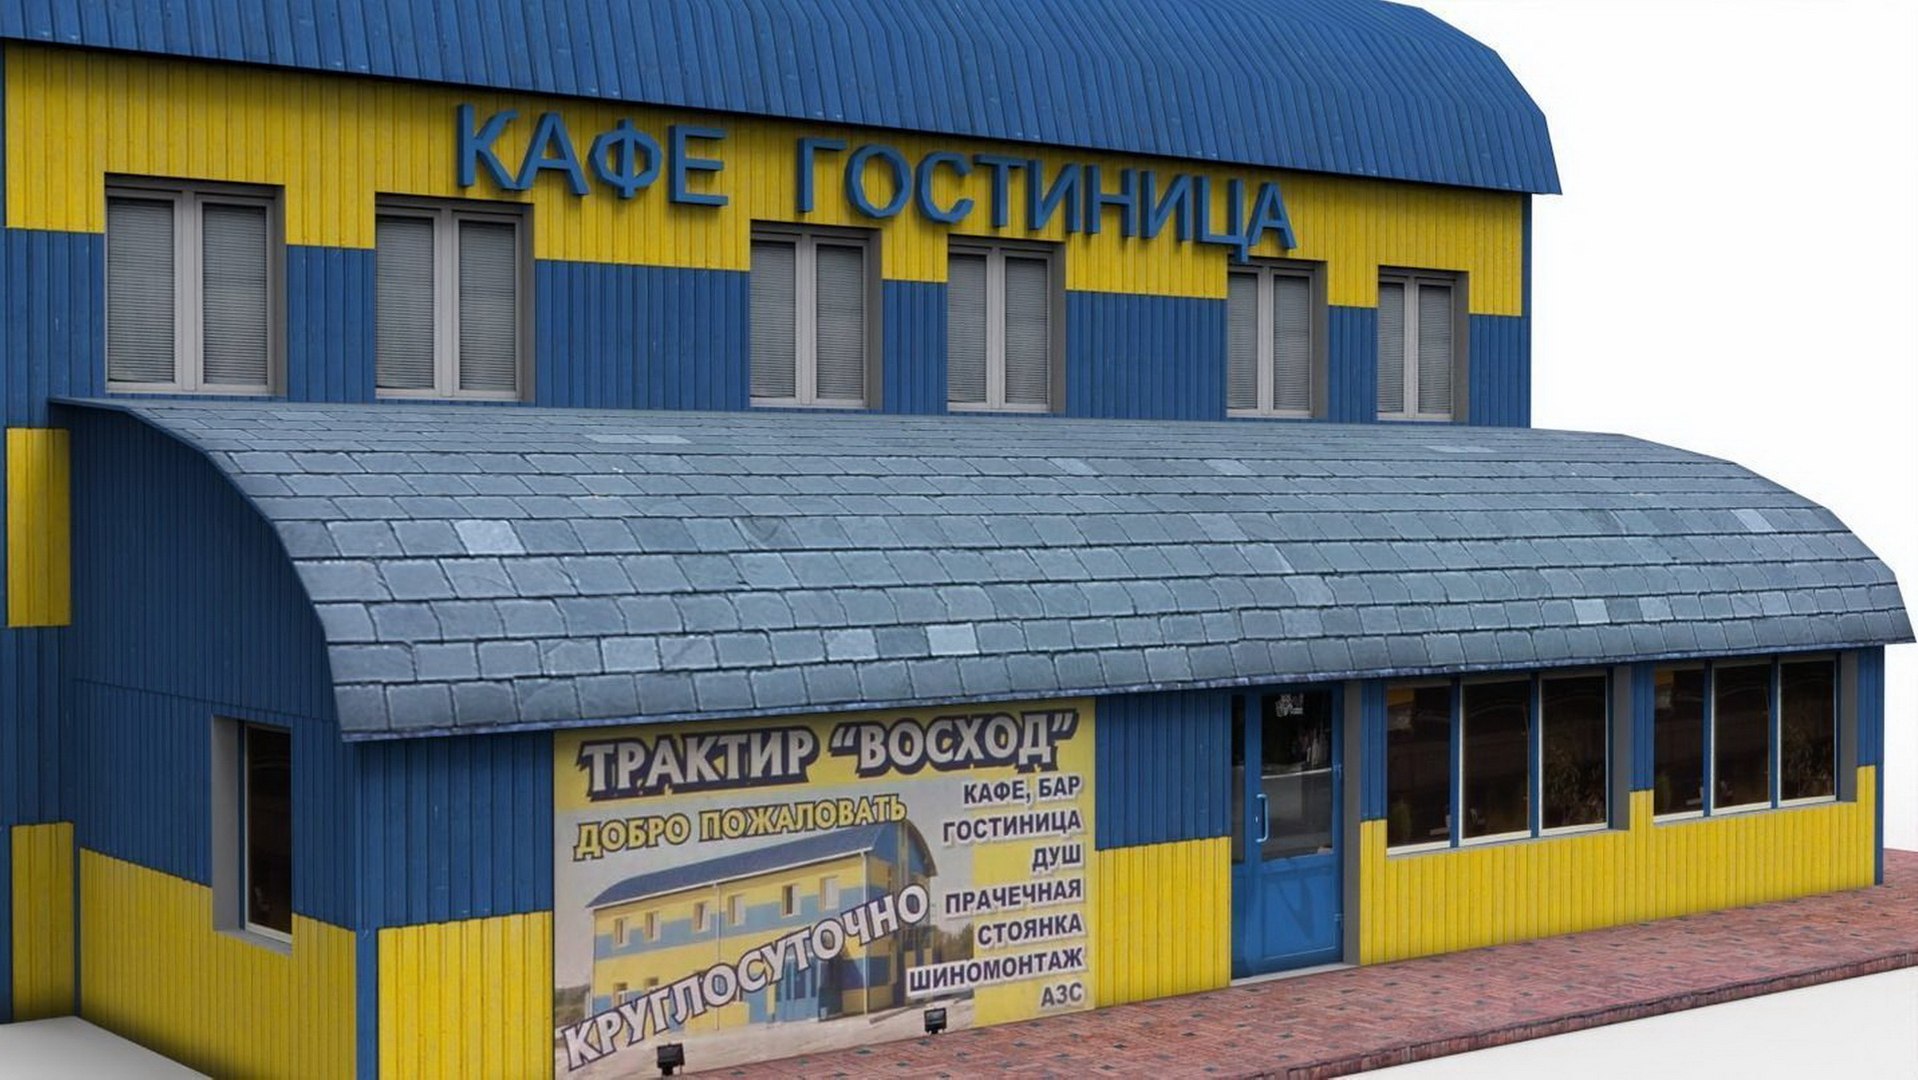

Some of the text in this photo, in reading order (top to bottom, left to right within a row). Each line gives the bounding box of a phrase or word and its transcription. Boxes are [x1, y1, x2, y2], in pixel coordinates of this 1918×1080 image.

[457, 103, 1297, 263] КАФЕ ГОСТИНИЦА
[578, 726, 819, 799] ТРАКТИР
[963, 775, 1081, 805] КАФЕ, БАР
[573, 794, 907, 861] ДОБРО ПОЖАЛОВАТЬ
[942, 812, 1082, 844] ГОСТИНИЦА
[1031, 843, 1082, 872] ДУШ
[945, 878, 1082, 915] ПРАЧЕЧНАЯ
[977, 914, 1083, 946] СТОЯНКА
[562, 884, 930, 1072] КРУГЛОСУТОЧНО
[908, 947, 1084, 994] ШИНОМОНТАЖ
[1041, 981, 1084, 1007] АЗС
